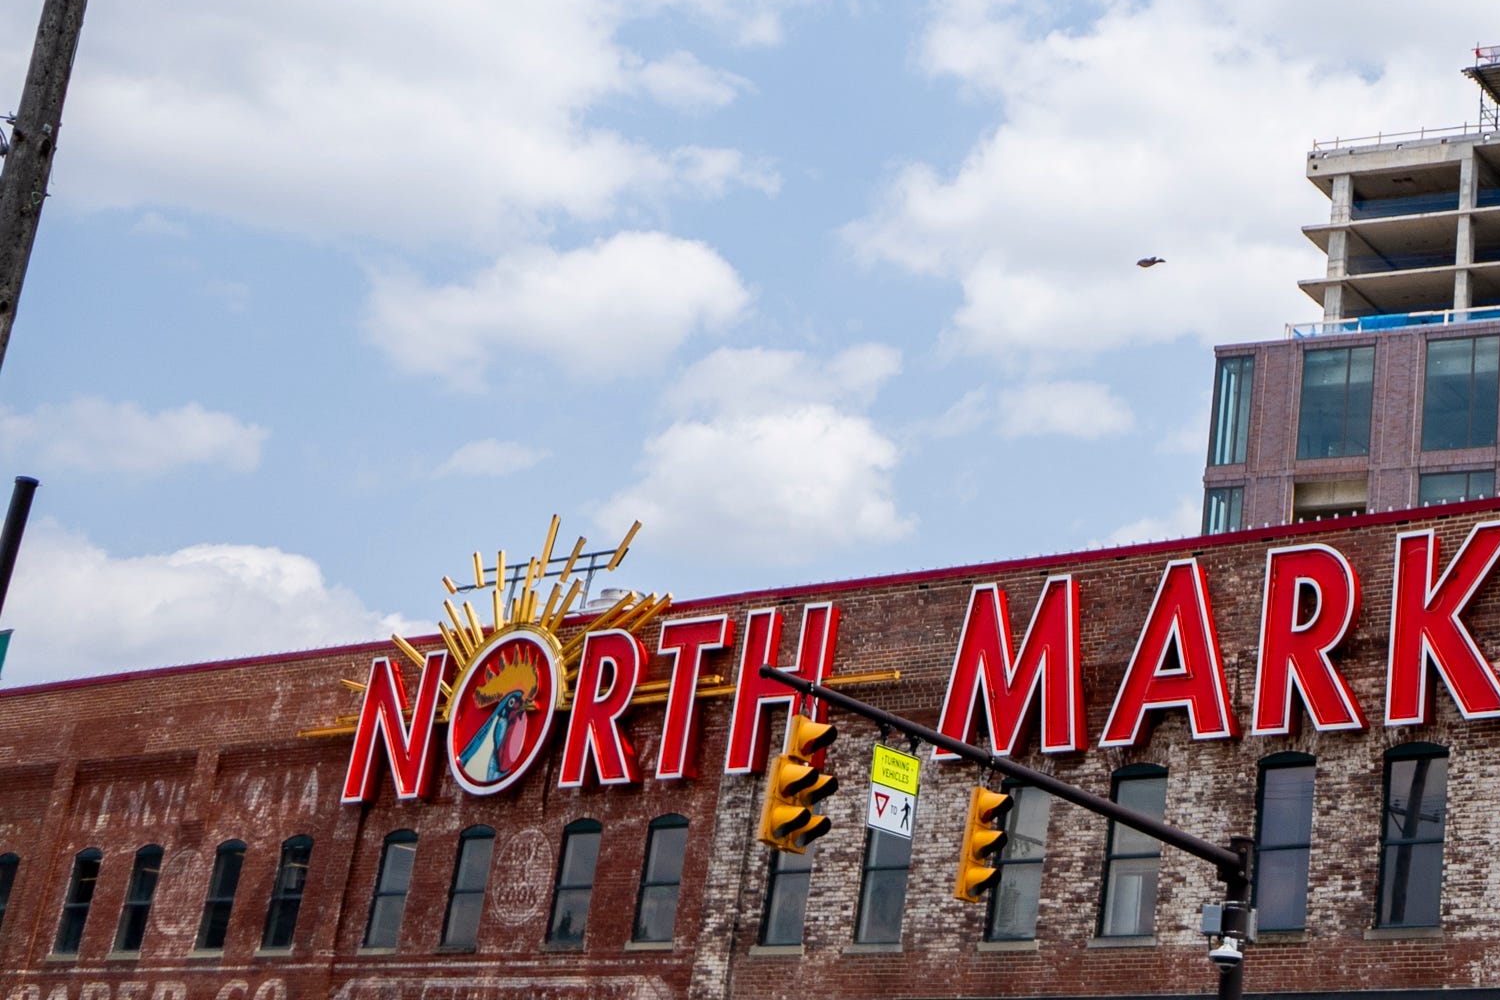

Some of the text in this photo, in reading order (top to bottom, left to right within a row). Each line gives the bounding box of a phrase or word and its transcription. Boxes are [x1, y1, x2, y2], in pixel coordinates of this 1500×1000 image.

[341, 601, 838, 803] NORTH
[884, 755, 910, 772] TURNING
[882, 767, 909, 784] VEHICLES
[890, 805, 897, 815] TO
